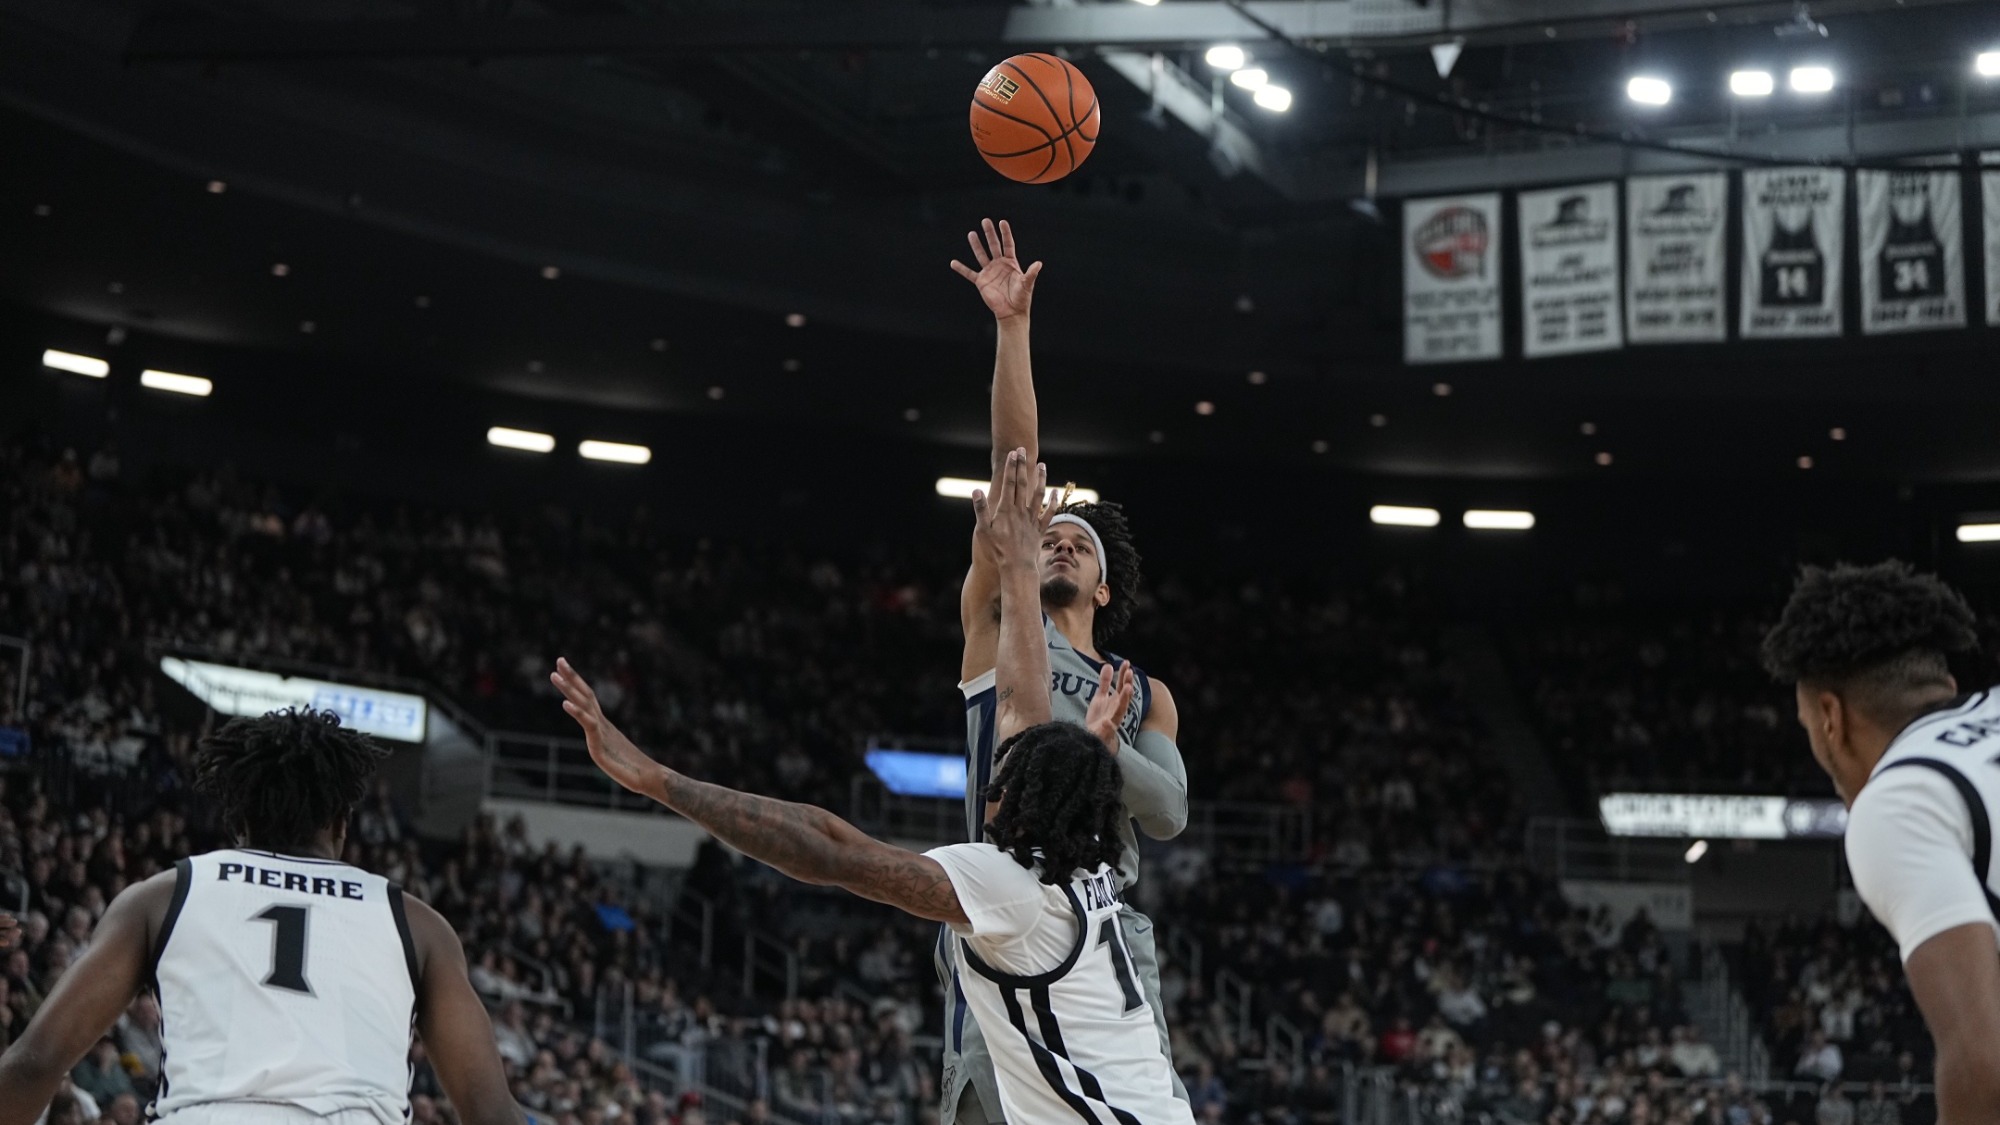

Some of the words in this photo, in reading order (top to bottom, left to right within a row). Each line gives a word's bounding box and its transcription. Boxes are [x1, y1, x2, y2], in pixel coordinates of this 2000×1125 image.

[1777, 266, 1808, 298] 14
[1894, 259, 1928, 292] 34
[217, 863, 363, 901] PIERRE
[246, 902, 318, 999] 1
